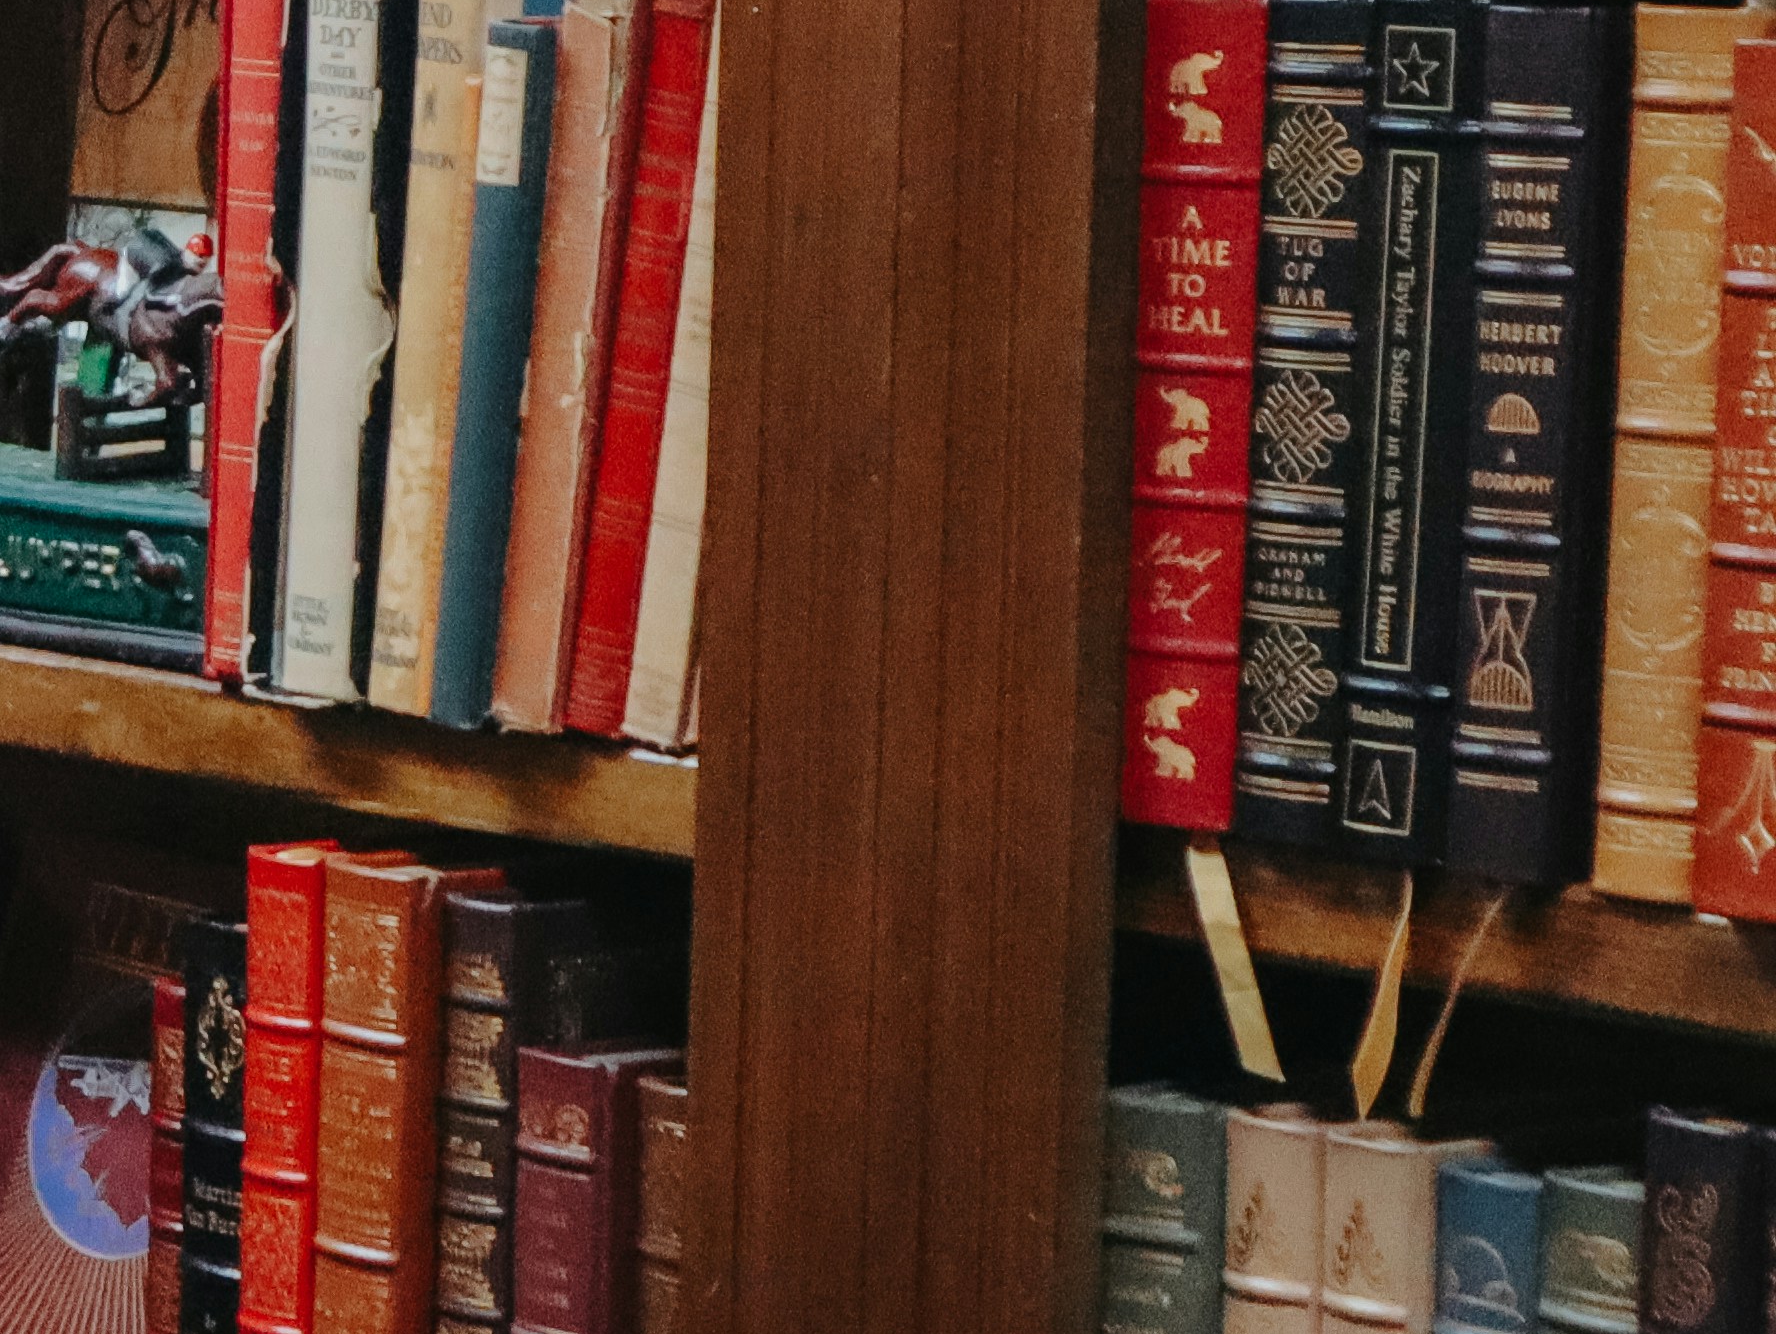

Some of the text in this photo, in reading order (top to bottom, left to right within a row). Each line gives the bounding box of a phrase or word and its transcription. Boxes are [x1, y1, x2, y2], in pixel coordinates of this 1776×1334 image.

[320, 23, 363, 48] DAY
[418, 36, 464, 65] APERS
[1491, 181, 1560, 204] EUGENE
[1182, 205, 1204, 230] A
[1397, 164, 1424, 262] Zachary
[1496, 208, 1552, 232] LYONS
[1154, 237, 1232, 268] TIME
[1278, 236, 1324, 259] TUG
[1167, 271, 1207, 299] TO
[1285, 262, 1316, 282] OF
[1278, 287, 1327, 308] WAR
[1392, 264, 1417, 341] Taylor
[1150, 305, 1230, 336] HEAL
[1480, 320, 1563, 347] HERBERT
[1480, 351, 1557, 378] HOOVER
[1388, 346, 1412, 430] Soldier
[1383, 436, 1402, 461] in
[1504, 447, 1517, 465] A
[1382, 467, 1405, 502] the
[1377, 505, 1404, 578] White
[1271, 567, 1305, 583] AND
